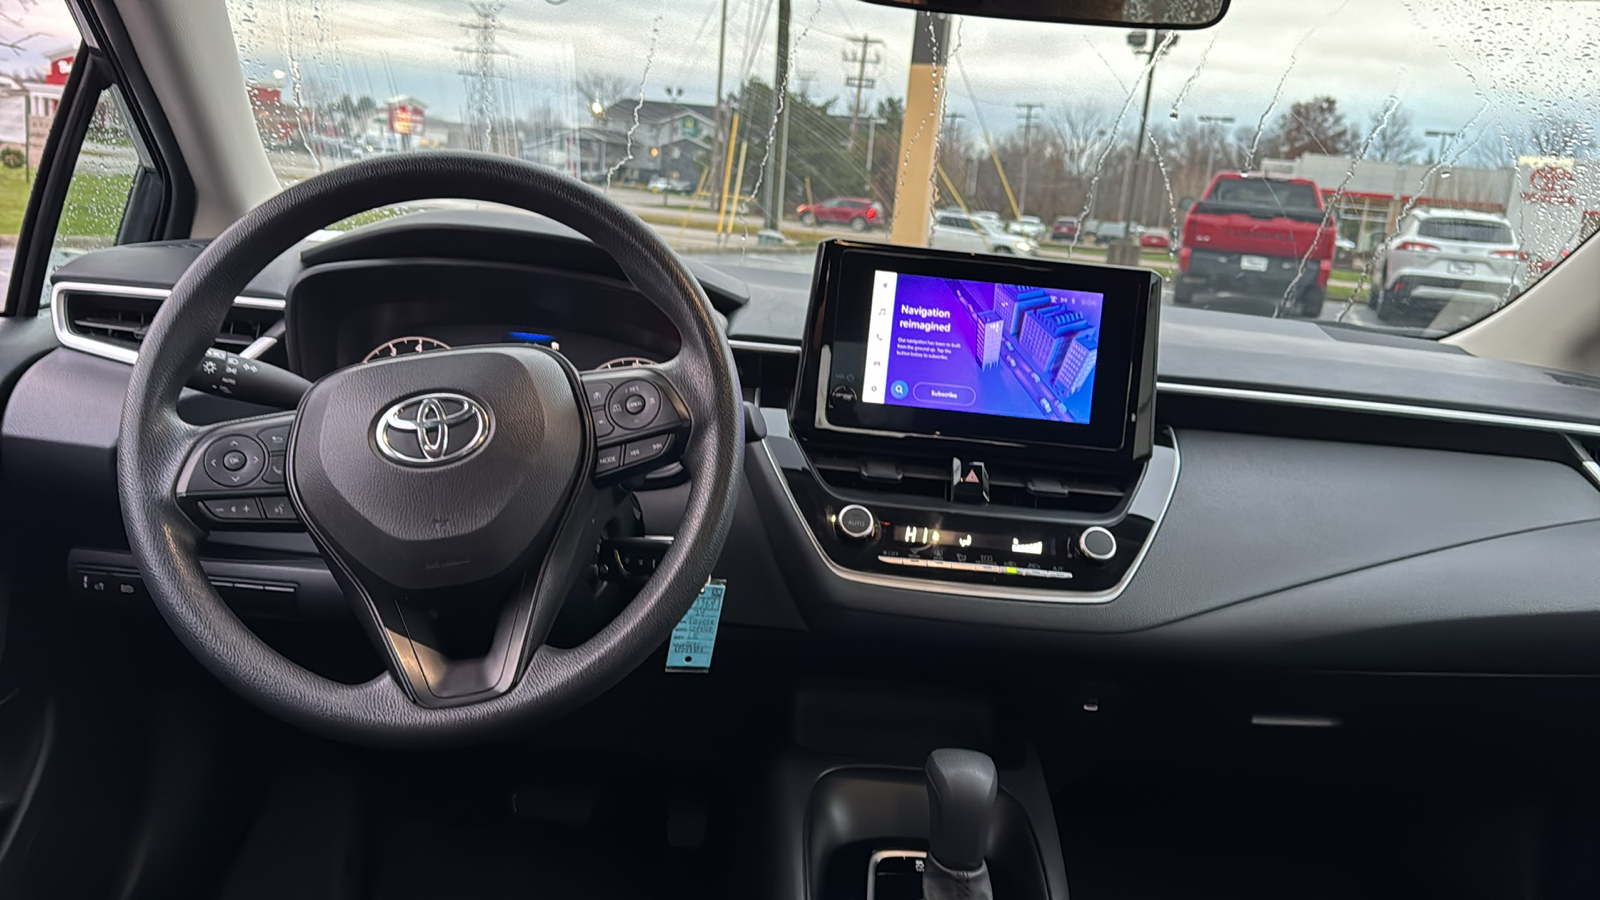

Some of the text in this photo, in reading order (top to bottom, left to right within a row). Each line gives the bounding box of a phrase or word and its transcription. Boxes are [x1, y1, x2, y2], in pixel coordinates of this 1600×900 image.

[901, 304, 951, 319] Navigation
[899, 319, 951, 333] reimagined
[931, 389, 958, 399] Subscribe
[848, 519, 865, 527] AUTO
